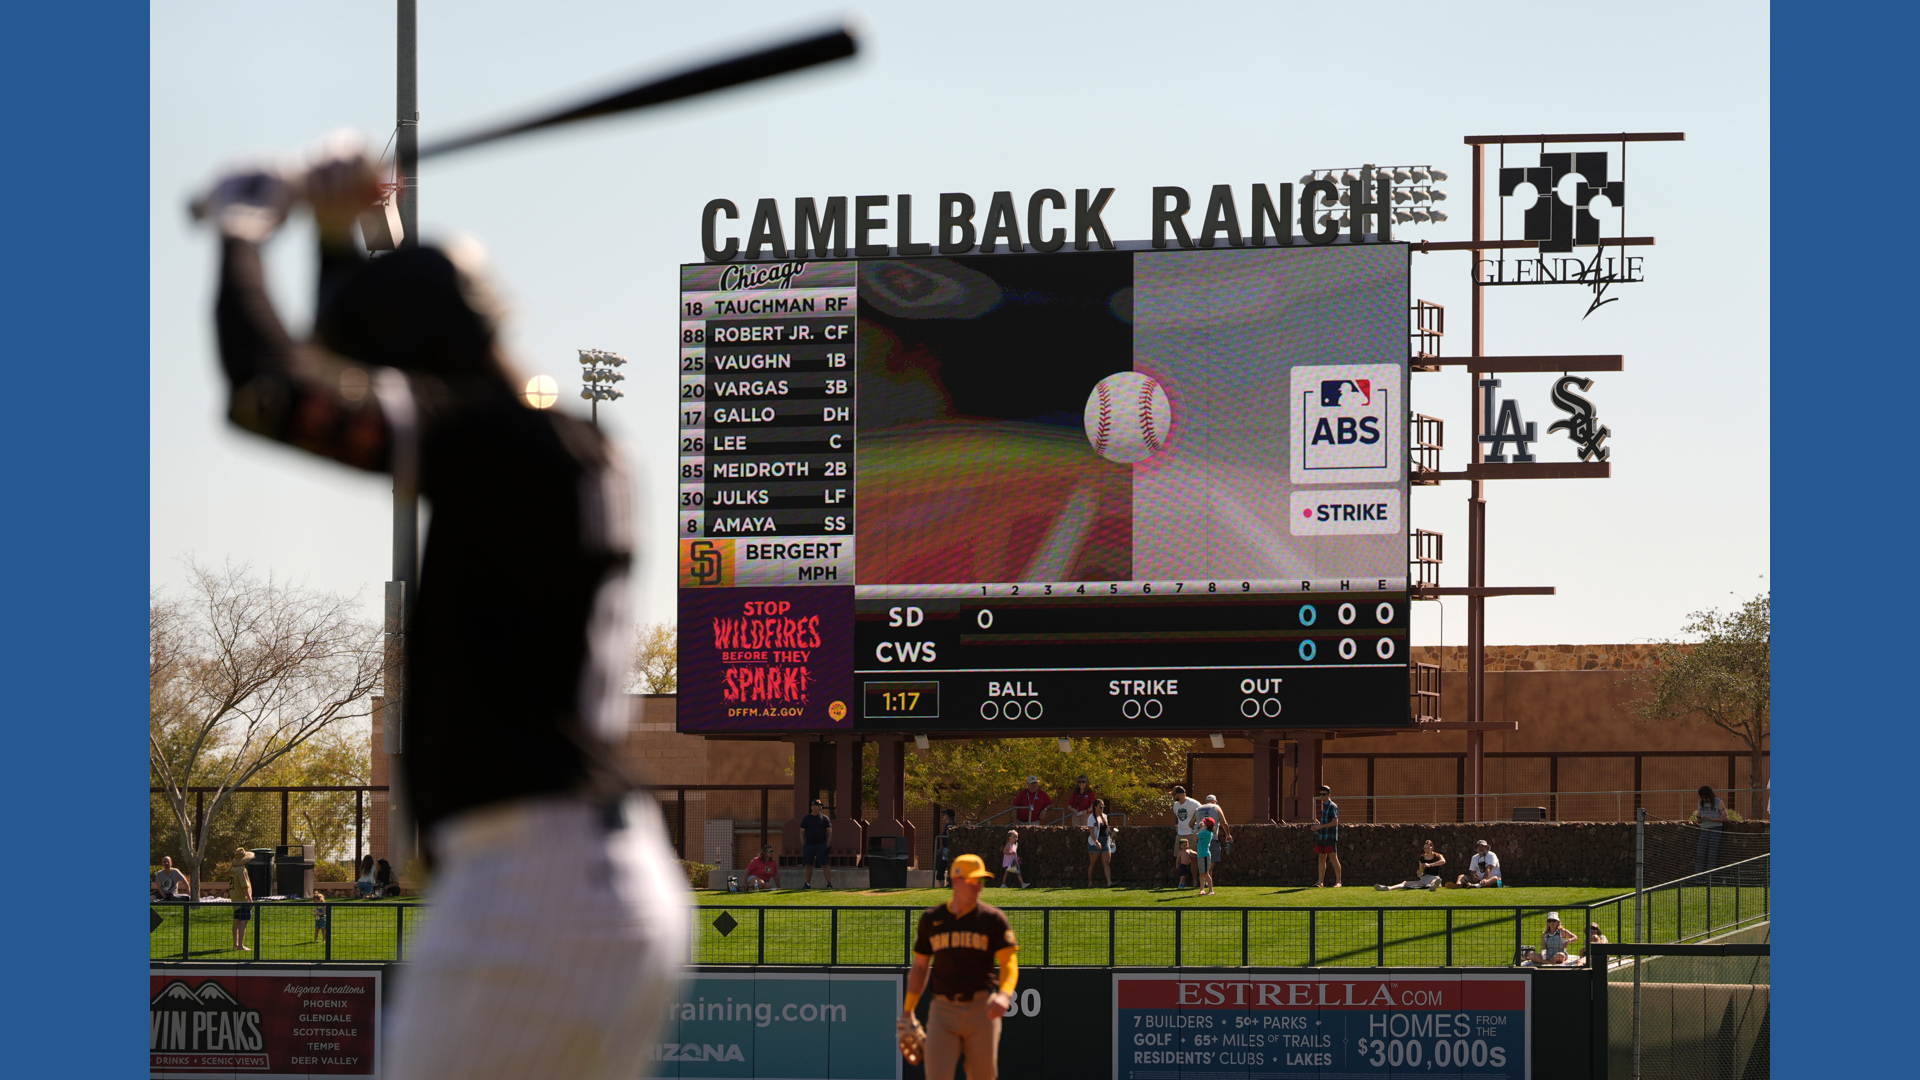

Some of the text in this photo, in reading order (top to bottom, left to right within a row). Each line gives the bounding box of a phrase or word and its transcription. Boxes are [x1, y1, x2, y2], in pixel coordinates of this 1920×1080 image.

[703, 179, 1392, 261] CAMELBACK RANCH
[720, 262, 804, 291] Chicago
[685, 297, 848, 316] 18 TAUCHMAN RF
[683, 325, 848, 343] 88 ROBERT JR. CF
[683, 353, 846, 371] 25 VAUGHN 1B
[682, 380, 847, 398] 20 VARGAS 3B
[684, 407, 849, 425] 17 GALLO DH
[1478, 379, 1537, 463] LA
[1311, 416, 1380, 445] ABS
[682, 434, 842, 452] 26 LEE C
[682, 461, 847, 478] 85 MEIDROTH 2B
[682, 489, 847, 506] 30 JULKS LF
[1317, 503, 1388, 521] STRIKE
[687, 516, 846, 533] 8 AMAYA SS
[690, 541, 842, 585] SD BERGERT
[799, 566, 837, 580] MPH
[981, 579, 1387, 596] 1 2 3 4 5 6 7 8 9 R H E
[743, 601, 791, 616] STOP
[889, 602, 1394, 629] SD 0 0 0 0
[713, 614, 821, 650] WILDFIRES
[722, 651, 811, 662] BEFORE THEY
[875, 637, 1395, 663] CWS 0 0 0
[722, 665, 810, 703] SPARK!
[882, 678, 1282, 711] 1:17 BALL STRIKE OUT
[728, 707, 804, 717] DFFM.AZ.GOV
[284, 983, 365, 997] Arizona Locations
[303, 1000, 348, 1008] PHOENIX
[663, 997, 847, 1028] raining.com
[299, 1014, 352, 1023] GLENDALE
[1133, 1015, 1307, 1029] 7 BUILDERS 50+ PARKS
[1369, 1013, 1507, 1038] HOMES FROM
[192, 1011, 263, 1051] PEAKS
[293, 1028, 357, 1037] SCOTTSDALE
[1134, 1033, 1331, 1047] GOLF 65+ MILES OF TRAILS
[1476, 1027, 1497, 1036] THE
[307, 1043, 340, 1051] TEMPE
[1358, 1038, 1507, 1070] $300,000s
[156, 1056, 265, 1066] DRINKS SCENIC VIEWS
[291, 1057, 359, 1066] DEER VALLEY
[1134, 1051, 1332, 1066] RESIDENTS' CLUBS LAKES
